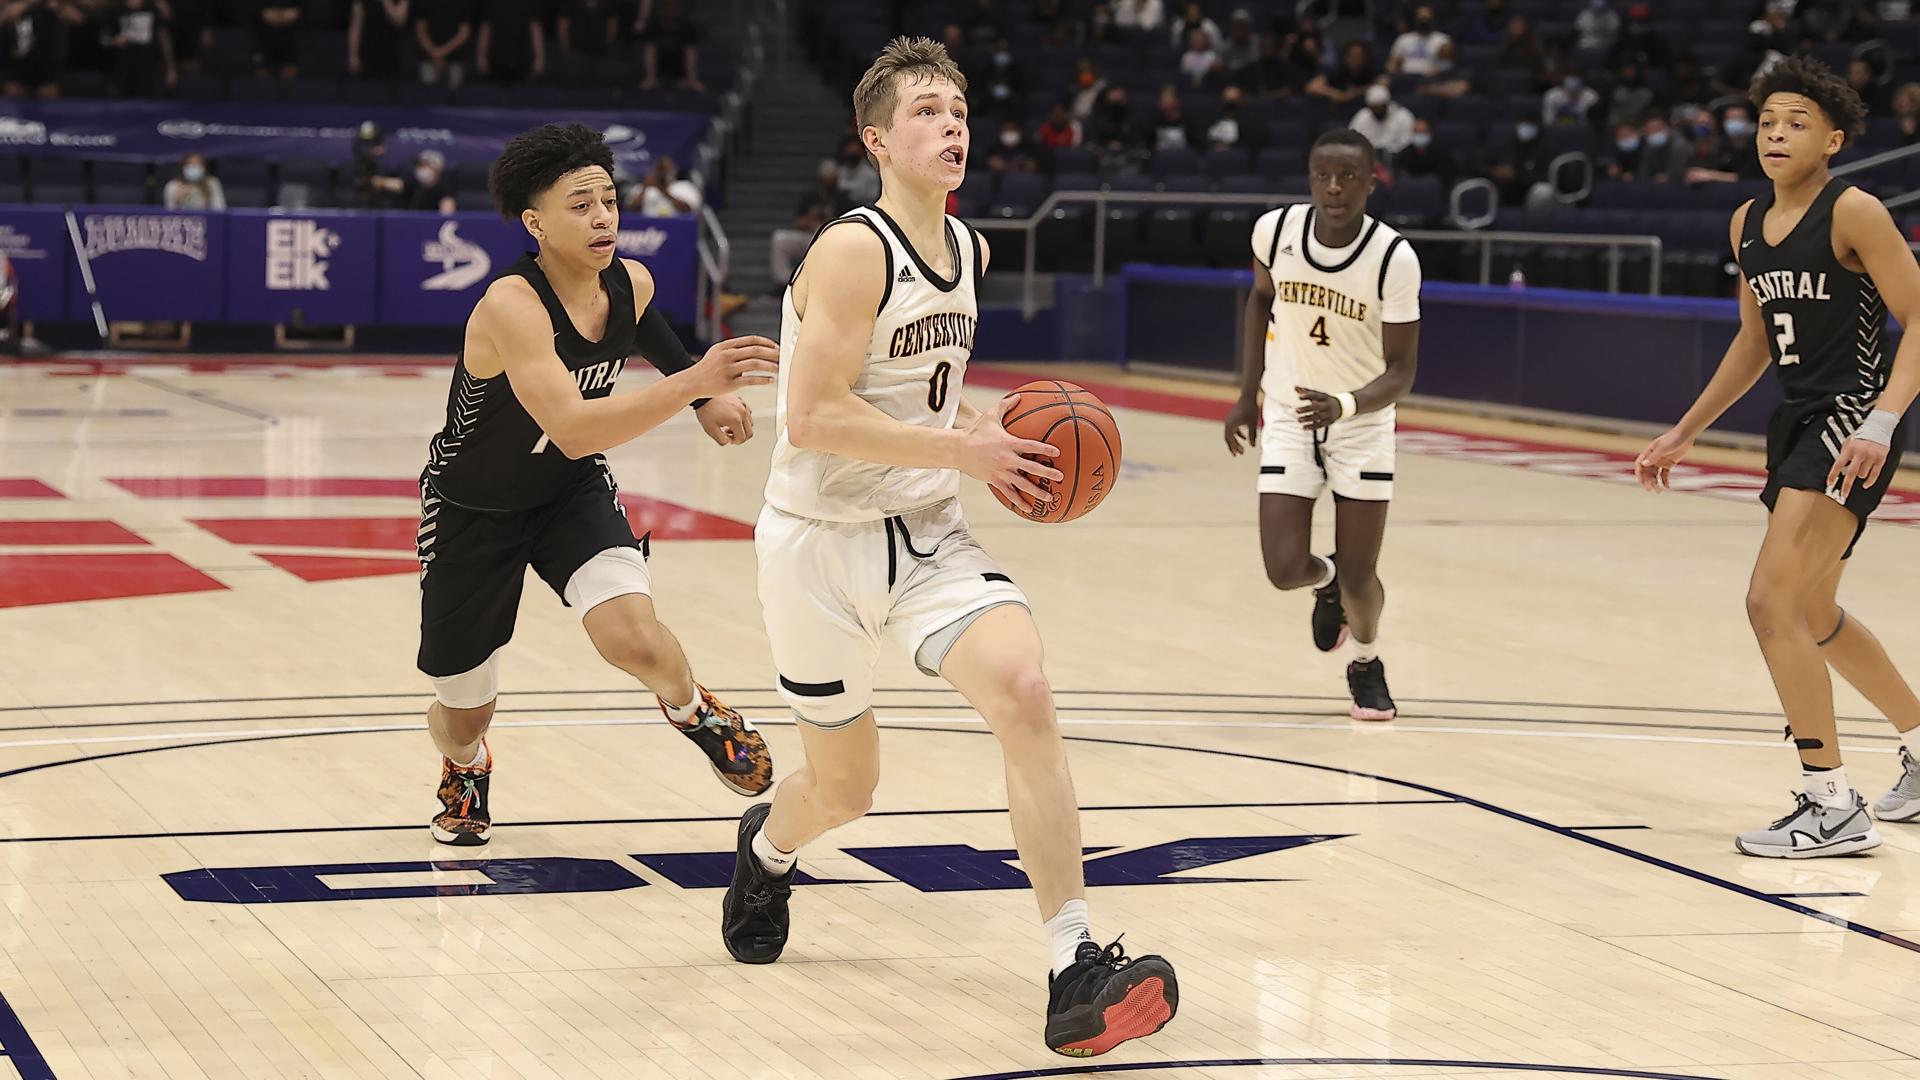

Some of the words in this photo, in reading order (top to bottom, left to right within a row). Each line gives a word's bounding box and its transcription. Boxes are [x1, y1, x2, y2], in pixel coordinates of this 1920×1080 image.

[265, 259, 330, 289] Elk
[1749, 270, 1831, 306] ENTRAL
[889, 312, 977, 358] CENTERVILL
[1309, 316, 1330, 346] 4
[1773, 312, 1800, 365] 2
[928, 361, 951, 412] 0
